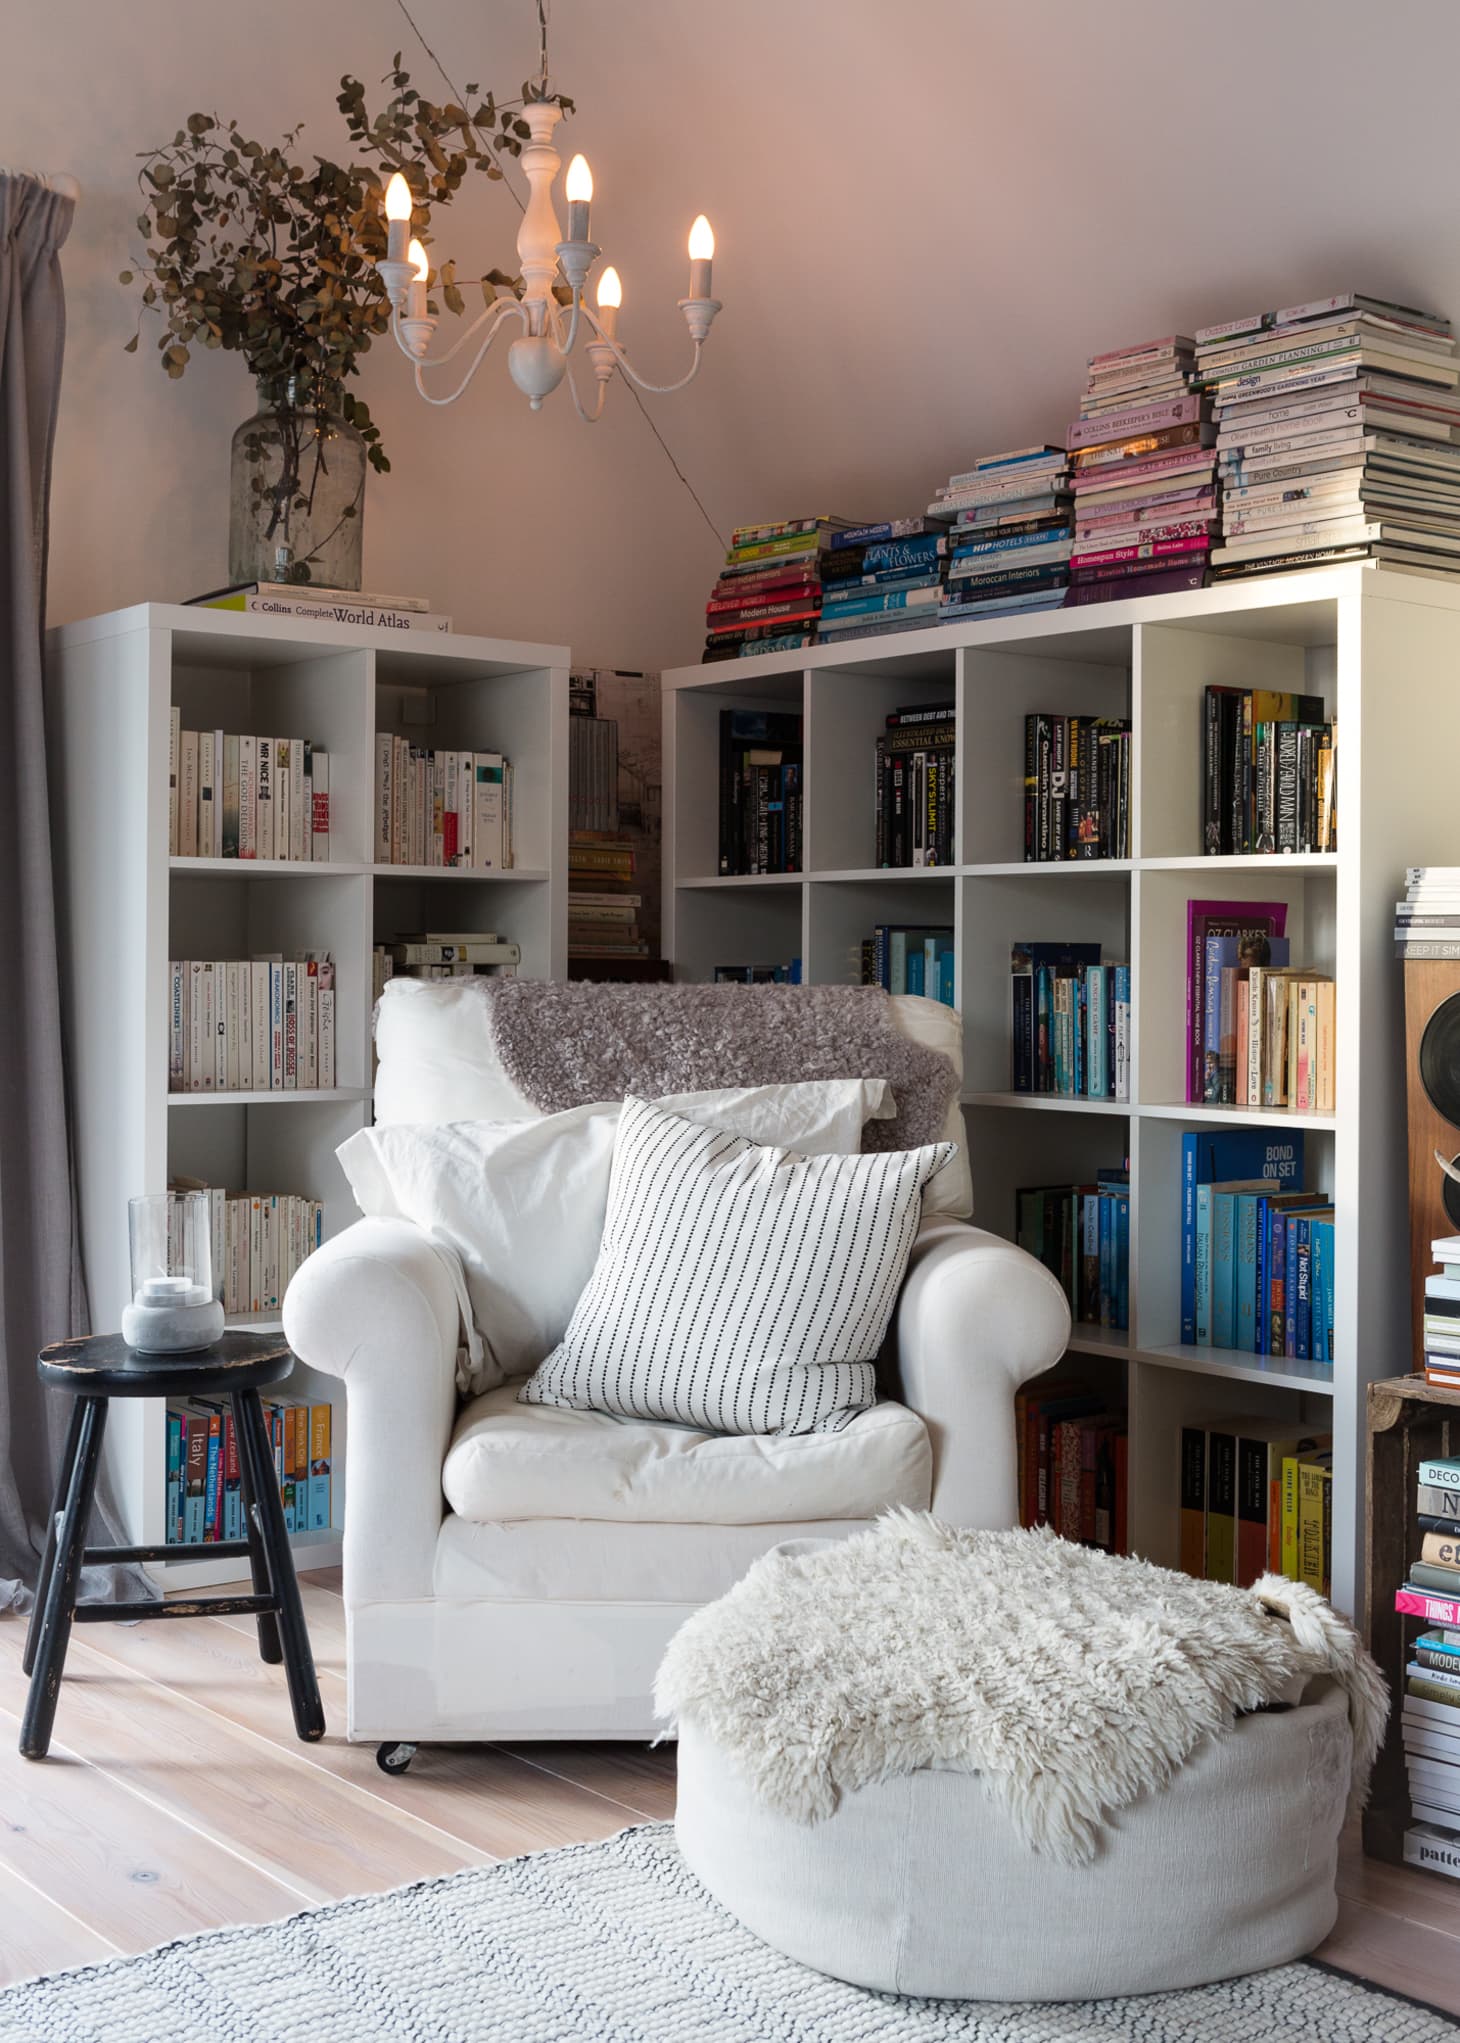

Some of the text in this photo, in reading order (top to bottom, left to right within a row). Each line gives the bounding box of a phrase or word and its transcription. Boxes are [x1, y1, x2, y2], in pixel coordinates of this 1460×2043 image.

[1205, 316, 1258, 337] Outdoor Living
[1241, 356, 1277, 371] GARDEN
[1278, 345, 1325, 363] PLANNING
[1237, 373, 1261, 388] design
[1310, 374, 1327, 383] YEAR
[1083, 421, 1111, 435] COLLINS
[1112, 413, 1150, 430] BEEKEEPER'S
[1151, 408, 1169, 420] BIBLE
[1268, 408, 1290, 419] home
[1251, 439, 1292, 455] family living
[1253, 465, 1302, 481] Pure Country
[867, 523, 890, 536] MODERN
[865, 543, 912, 561] PLANTS &
[973, 542, 993, 553] HIP
[993, 537, 1024, 550] HOTELS
[889, 551, 936, 567] FLOWERS
[1077, 550, 1115, 566] Homespun
[1115, 548, 1135, 561] Style
[1126, 560, 1166, 575] Homemade
[1167, 556, 1189, 568] Home
[971, 567, 1041, 587] Moroccan Interiors
[262, 602, 410, 630] Collins Complete World Atlas
[739, 603, 792, 620] Modern House
[900, 713, 921, 725] BETWEEN
[921, 711, 936, 720] DEBT
[936, 710, 947, 719] AND
[260, 742, 270, 759] MR
[892, 736, 933, 749] ESSENTIAL
[260, 761, 270, 783] NICE
[1056, 761, 1062, 770] A
[928, 767, 937, 799] SKY'S
[939, 756, 947, 801] sleepers
[1052, 771, 1064, 799] DJ
[241, 760, 249, 850] THE GOD DELUSION
[447, 781, 456, 811] Bryson
[928, 803, 937, 832] LIMIT
[1280, 796, 1296, 822] MAN
[1056, 823, 1061, 836] MY
[1206, 940, 1219, 975] Gordon
[1431, 945, 1440, 956] IT
[288, 1035, 296, 1046] OF
[288, 1047, 296, 1076] BOSSES
[1251, 1040, 1259, 1065] History
[1250, 1072, 1258, 1090] Love
[1266, 1145, 1293, 1161] BOND
[1263, 1161, 1297, 1178] ON SET
[1298, 1257, 1309, 1300] Not Stupid
[315, 1423, 326, 1457] France
[189, 1433, 206, 1466] Italy
[206, 1445, 218, 1516] The Netherlands
[1302, 1471, 1311, 1480] THE
[1428, 1468, 1460, 1483] DECO
[1304, 1519, 1320, 1577] TOLKIEN
[1425, 1599, 1454, 1622] THINGS
